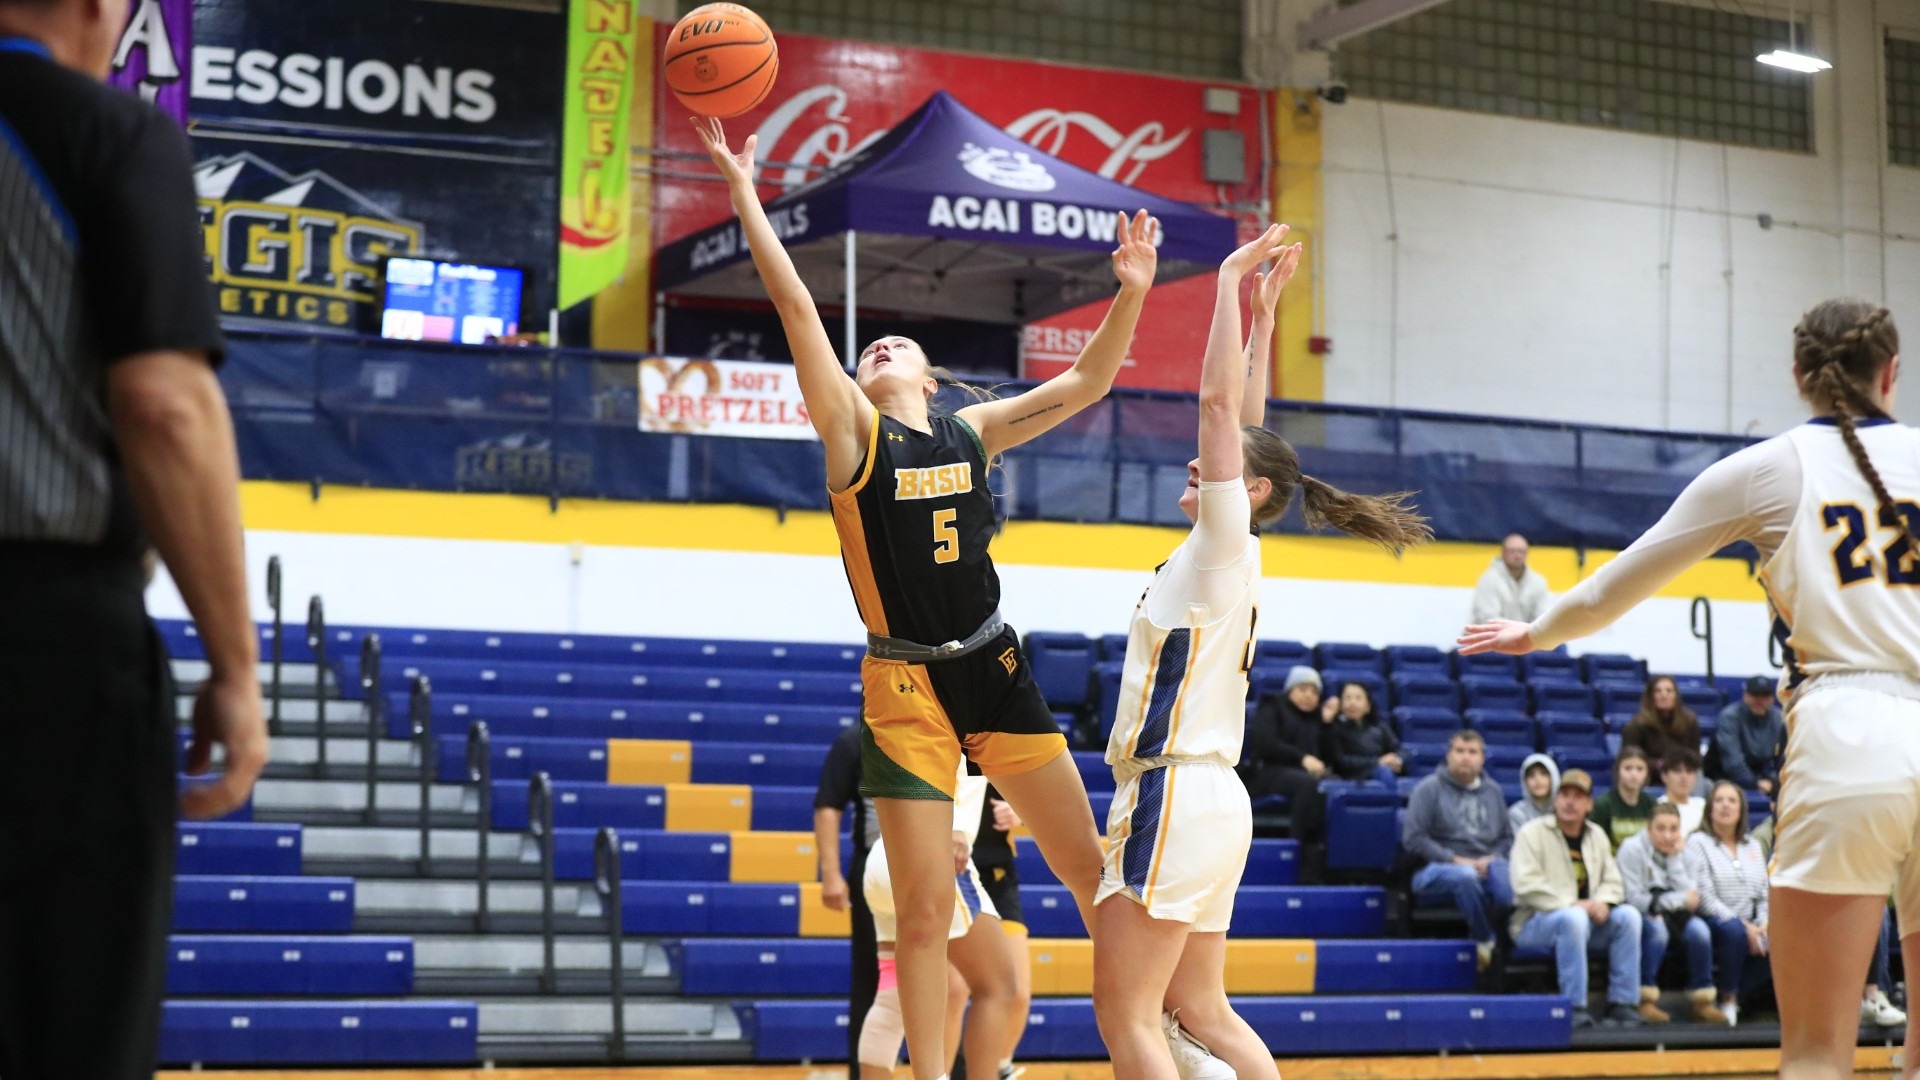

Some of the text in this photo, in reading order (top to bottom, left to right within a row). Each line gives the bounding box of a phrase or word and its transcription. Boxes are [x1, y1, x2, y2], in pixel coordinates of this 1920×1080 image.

[680, 20, 725, 42] EVO
[190, 45, 497, 122] ESSIONS
[928, 195, 1165, 248] ACAI BOWS
[730, 371, 782, 392] SOFT
[657, 394, 811, 425] PRETZELS
[895, 462, 973, 500] BHSU
[933, 508, 960, 564] 5
[1819, 499, 1920, 590] 22
